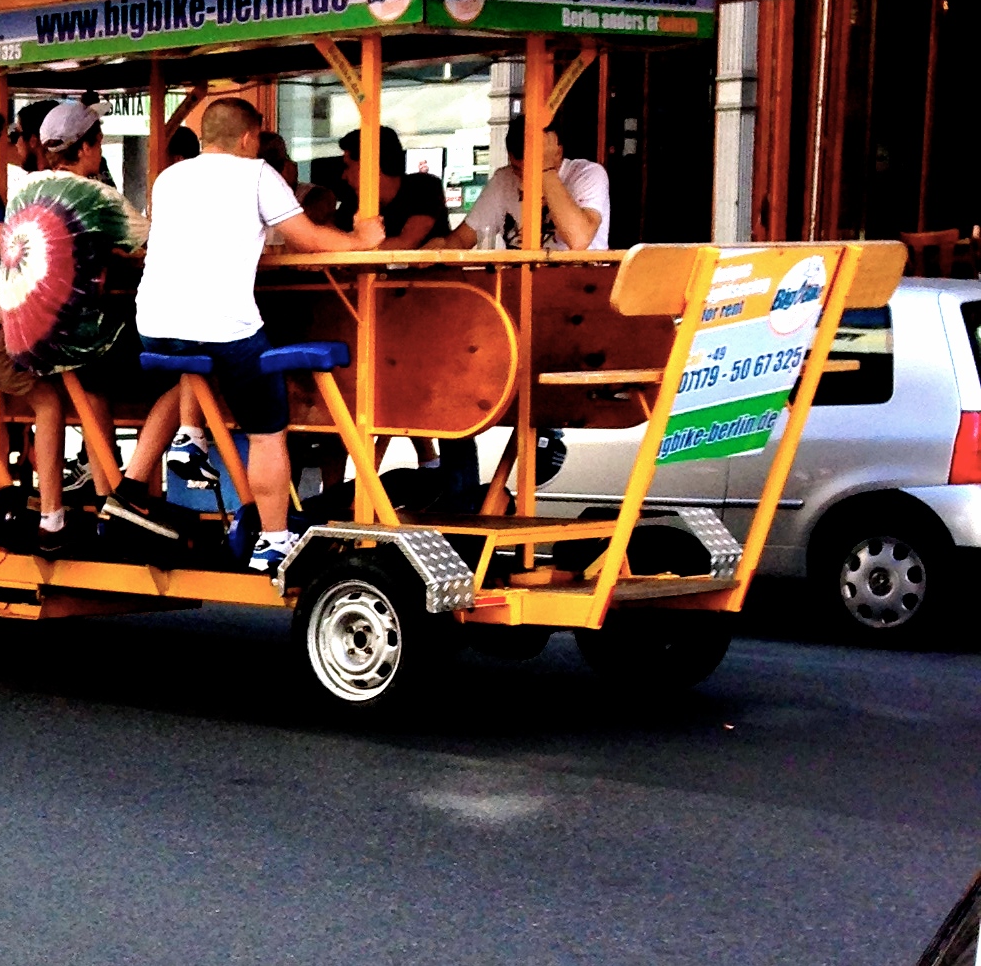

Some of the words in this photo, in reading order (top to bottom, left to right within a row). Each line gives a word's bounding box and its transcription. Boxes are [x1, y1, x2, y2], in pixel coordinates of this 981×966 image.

[730, 358, 752, 382] 50
[753, 353, 773, 377] 67
[773, 346, 803, 372] 325
